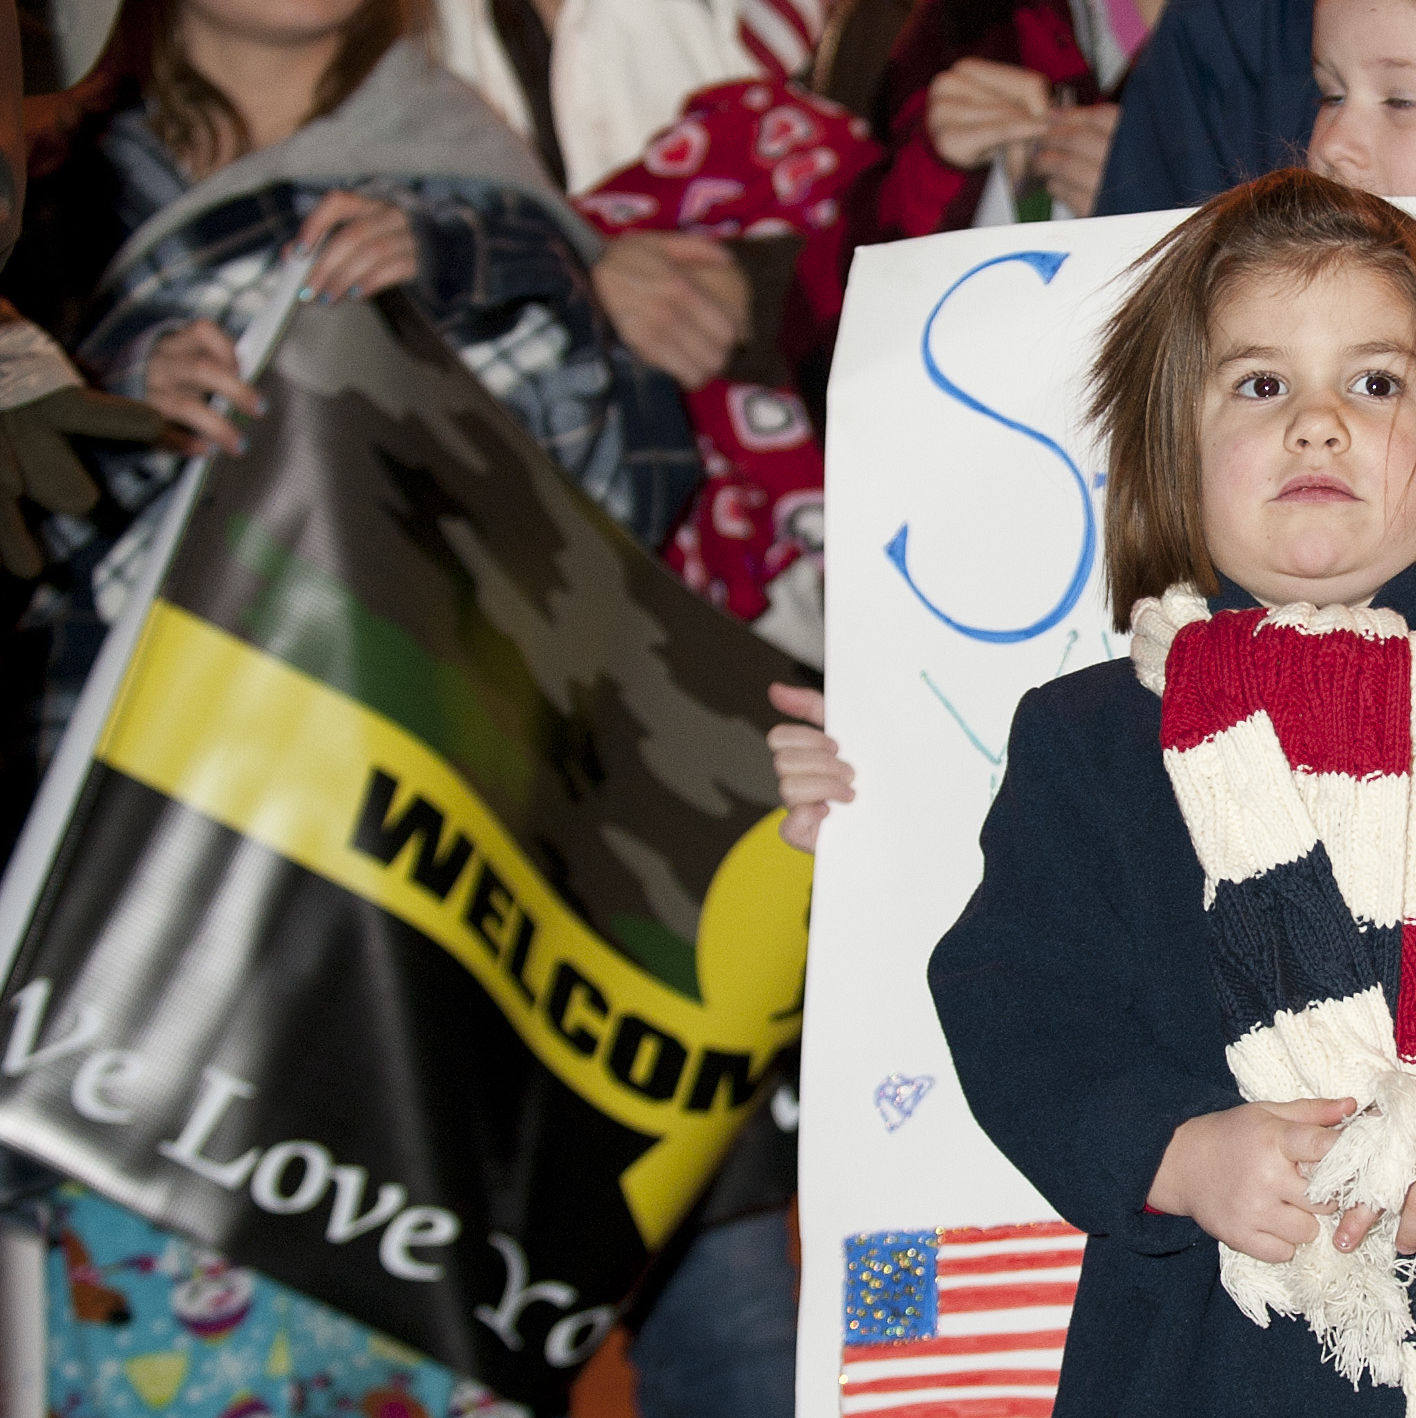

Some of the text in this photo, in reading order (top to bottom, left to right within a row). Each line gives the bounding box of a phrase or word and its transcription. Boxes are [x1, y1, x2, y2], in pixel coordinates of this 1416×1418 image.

[350, 766, 758, 1114] WELCOM
[157, 1067, 461, 1281] Love
[474, 1231, 618, 1369] Yo
